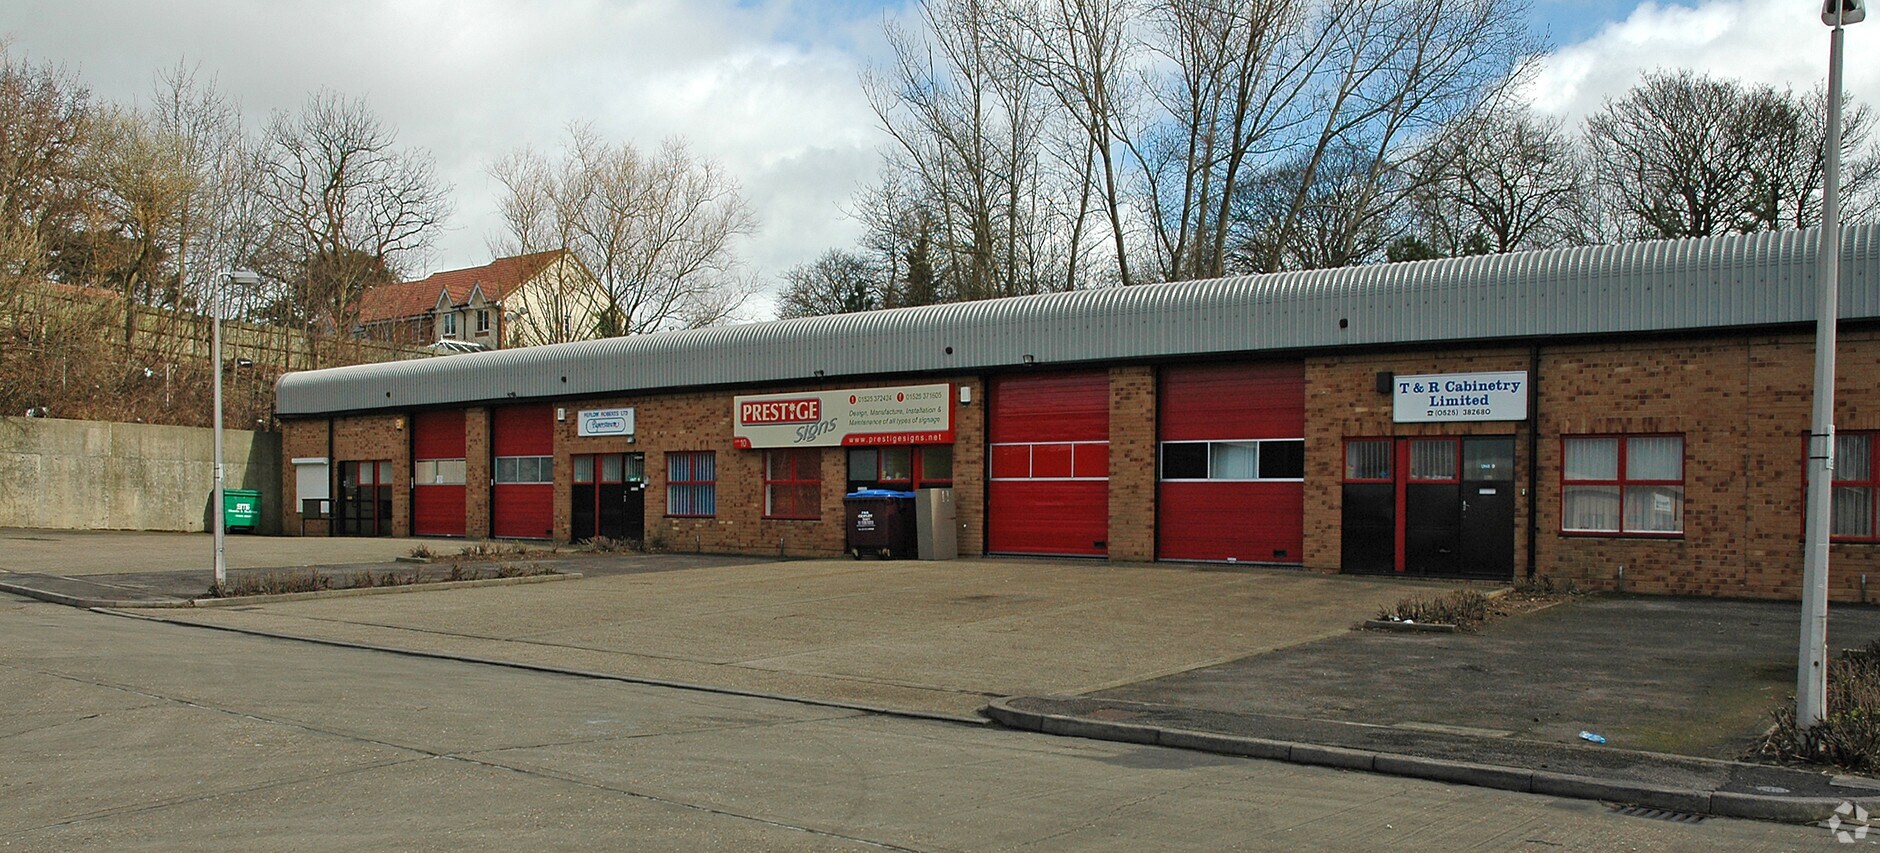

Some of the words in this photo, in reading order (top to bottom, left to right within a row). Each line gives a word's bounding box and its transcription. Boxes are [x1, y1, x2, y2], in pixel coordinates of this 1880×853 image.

[1400, 383, 1409, 393] T
[1413, 382, 1424, 393] &
[1428, 382, 1440, 392] R
[1445, 380, 1521, 393] Cabinetry
[1429, 394, 1489, 407] Limited
[743, 401, 817, 421] PRESTIGE
[905, 406, 936, 414] Installation
[897, 418, 911, 426] types
[849, 433, 942, 444] www.prestigesigns.net
